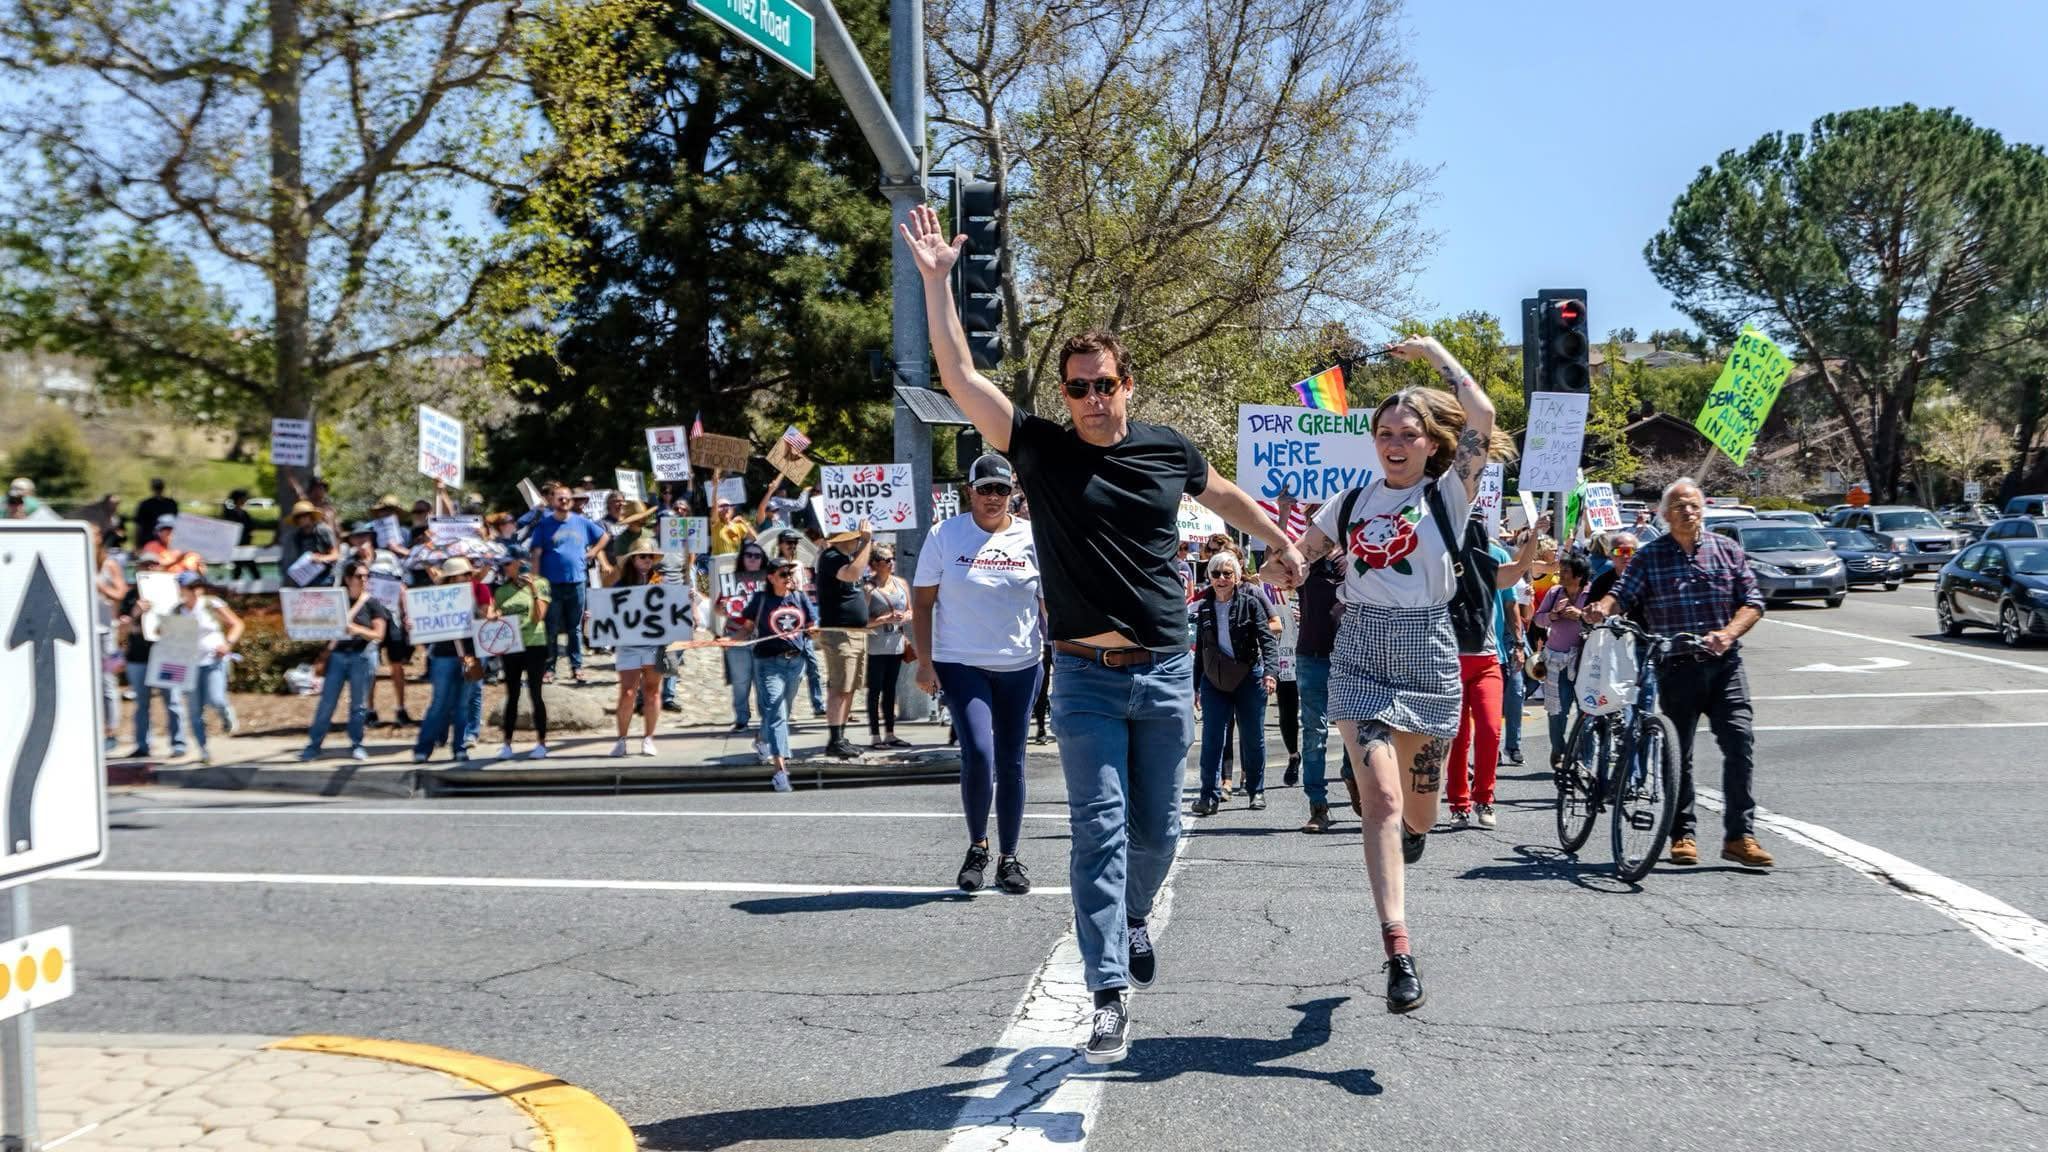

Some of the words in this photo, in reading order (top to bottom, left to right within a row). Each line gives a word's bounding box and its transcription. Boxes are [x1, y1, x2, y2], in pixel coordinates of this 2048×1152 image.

[727, 0, 757, 24] nez
[760, 0, 791, 47] Road
[1740, 334, 1785, 379] RESIST
[1535, 398, 1566, 417] TAX
[1248, 414, 1293, 434] DEAR
[1298, 413, 1373, 436] GREENLA
[1704, 417, 1722, 438] IN
[1721, 432, 1743, 457] USA
[1254, 439, 1322, 467] WE'RE
[828, 483, 892, 498] HANDS
[840, 500, 874, 515] OFF
[1176, 521, 1200, 530] EOPLE
[1188, 534, 1210, 544] POWE
[956, 555, 1026, 567] Accelerated
[412, 587, 460, 604] TRUMP
[428, 603, 440, 613] IS
